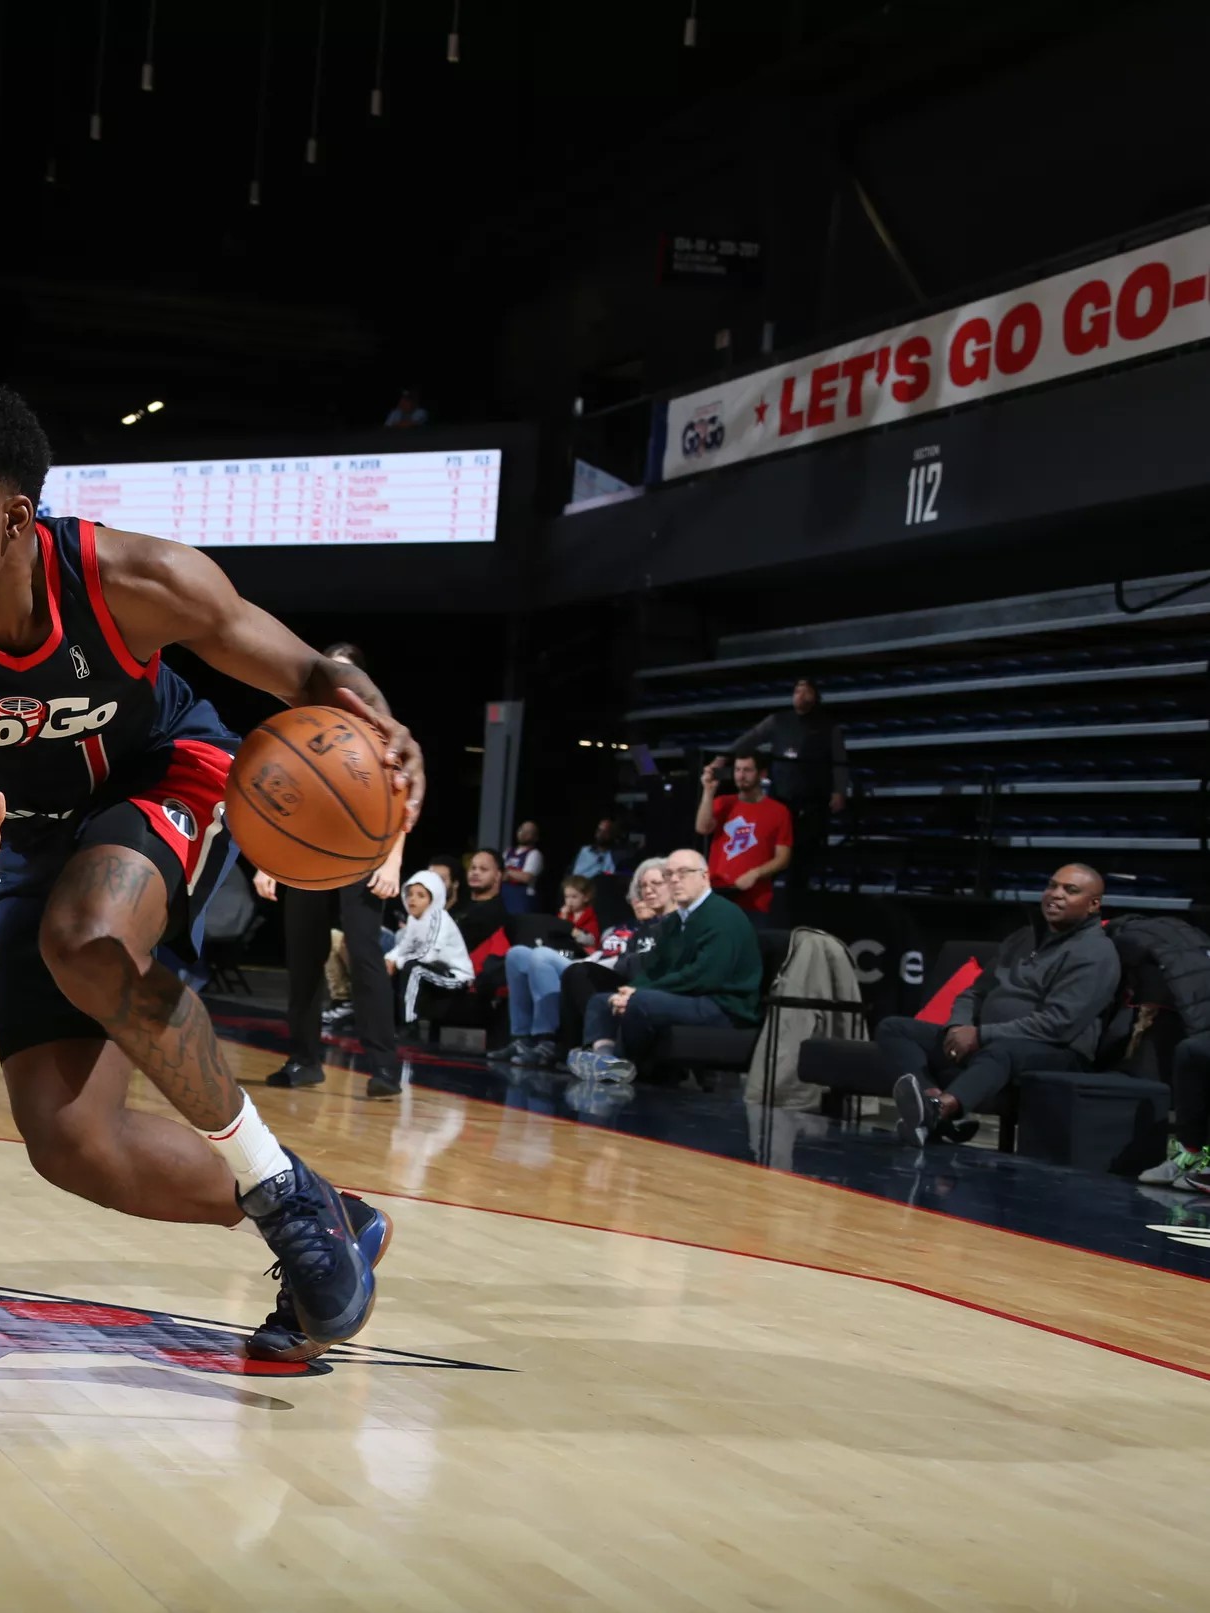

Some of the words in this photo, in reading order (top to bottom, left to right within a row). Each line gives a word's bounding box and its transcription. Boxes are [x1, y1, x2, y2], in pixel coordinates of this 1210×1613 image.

[778, 336, 932, 436] LET'S
[948, 302, 1042, 388] GO
[1063, 262, 1210, 355] GO-
[905, 461, 943, 526] 112
[74, 733, 111, 795] 1
